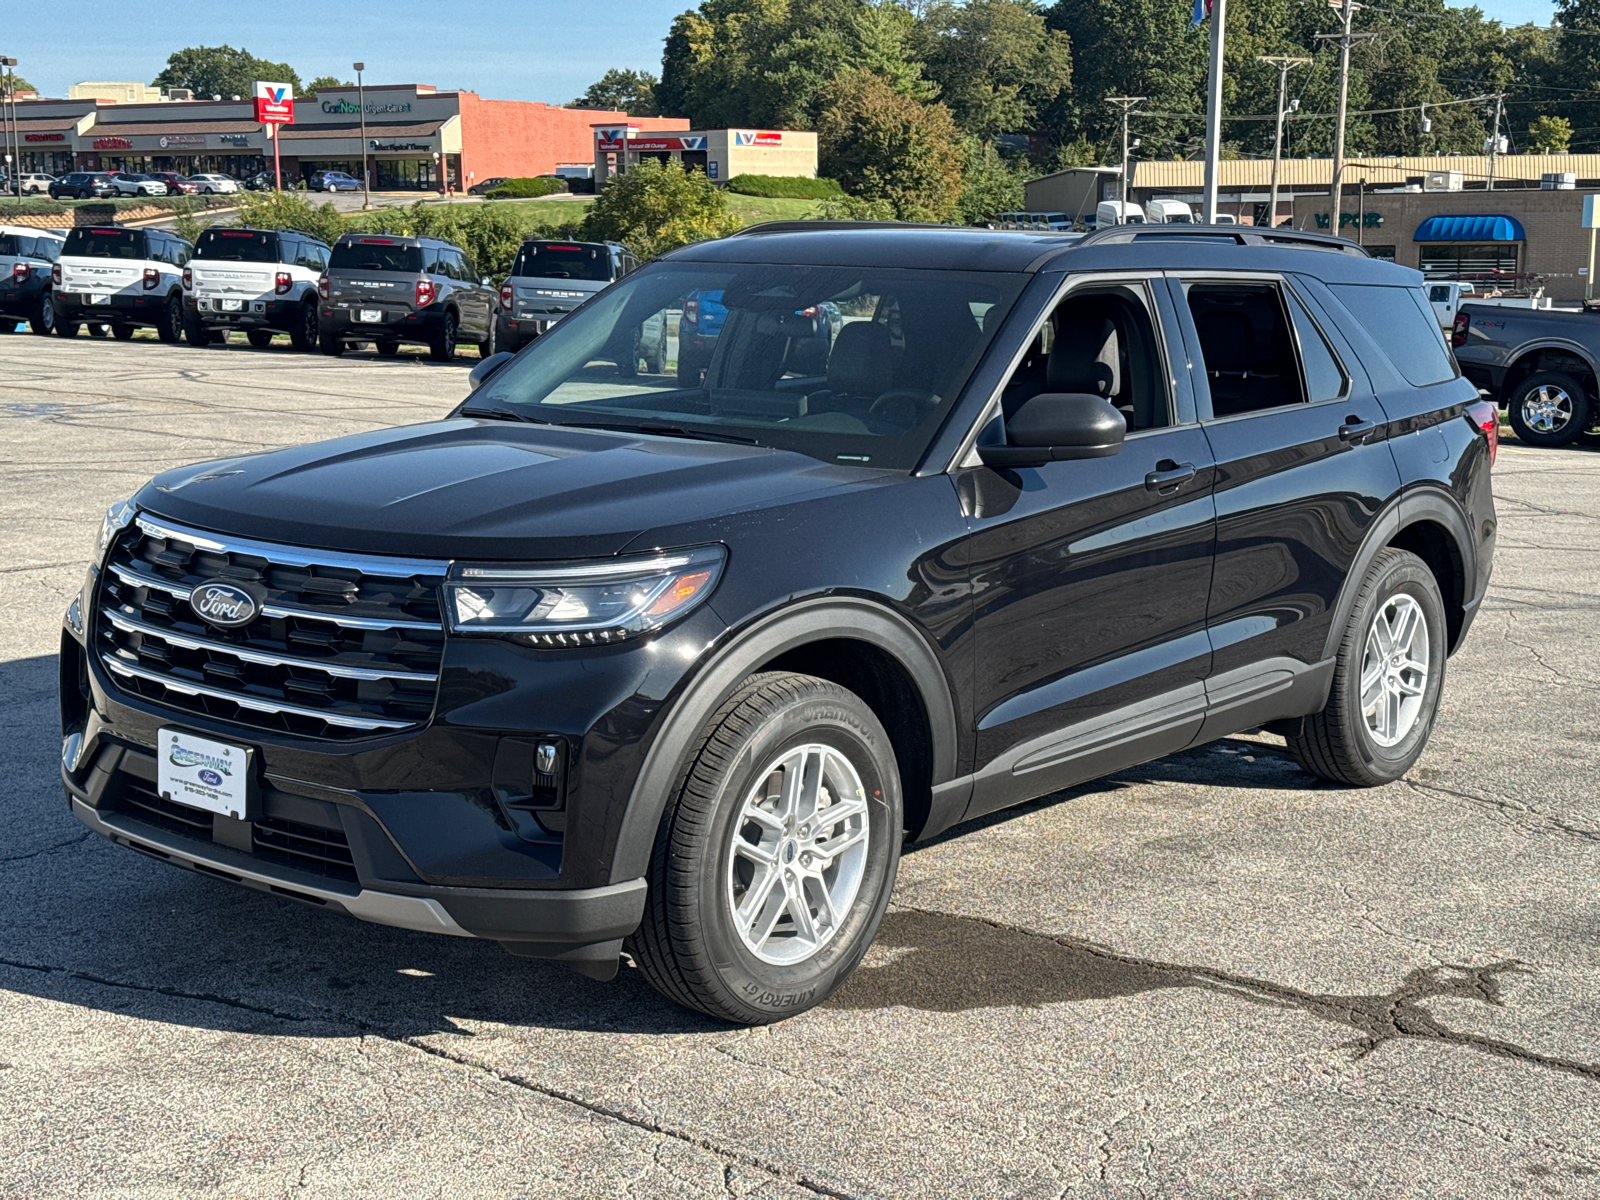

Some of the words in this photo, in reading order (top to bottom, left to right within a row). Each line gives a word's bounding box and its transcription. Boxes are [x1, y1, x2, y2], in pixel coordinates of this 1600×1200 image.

[264, 105, 289, 113] Valvoline
[364, 104, 386, 114] Urgent
[387, 104, 403, 112] Care
[200, 588, 243, 618] Ford
[170, 744, 232, 772] GREENWAY
[202, 771, 218, 785] Ford
[741, 981, 759, 995] GT
[755, 987, 817, 1008] KINERGY
